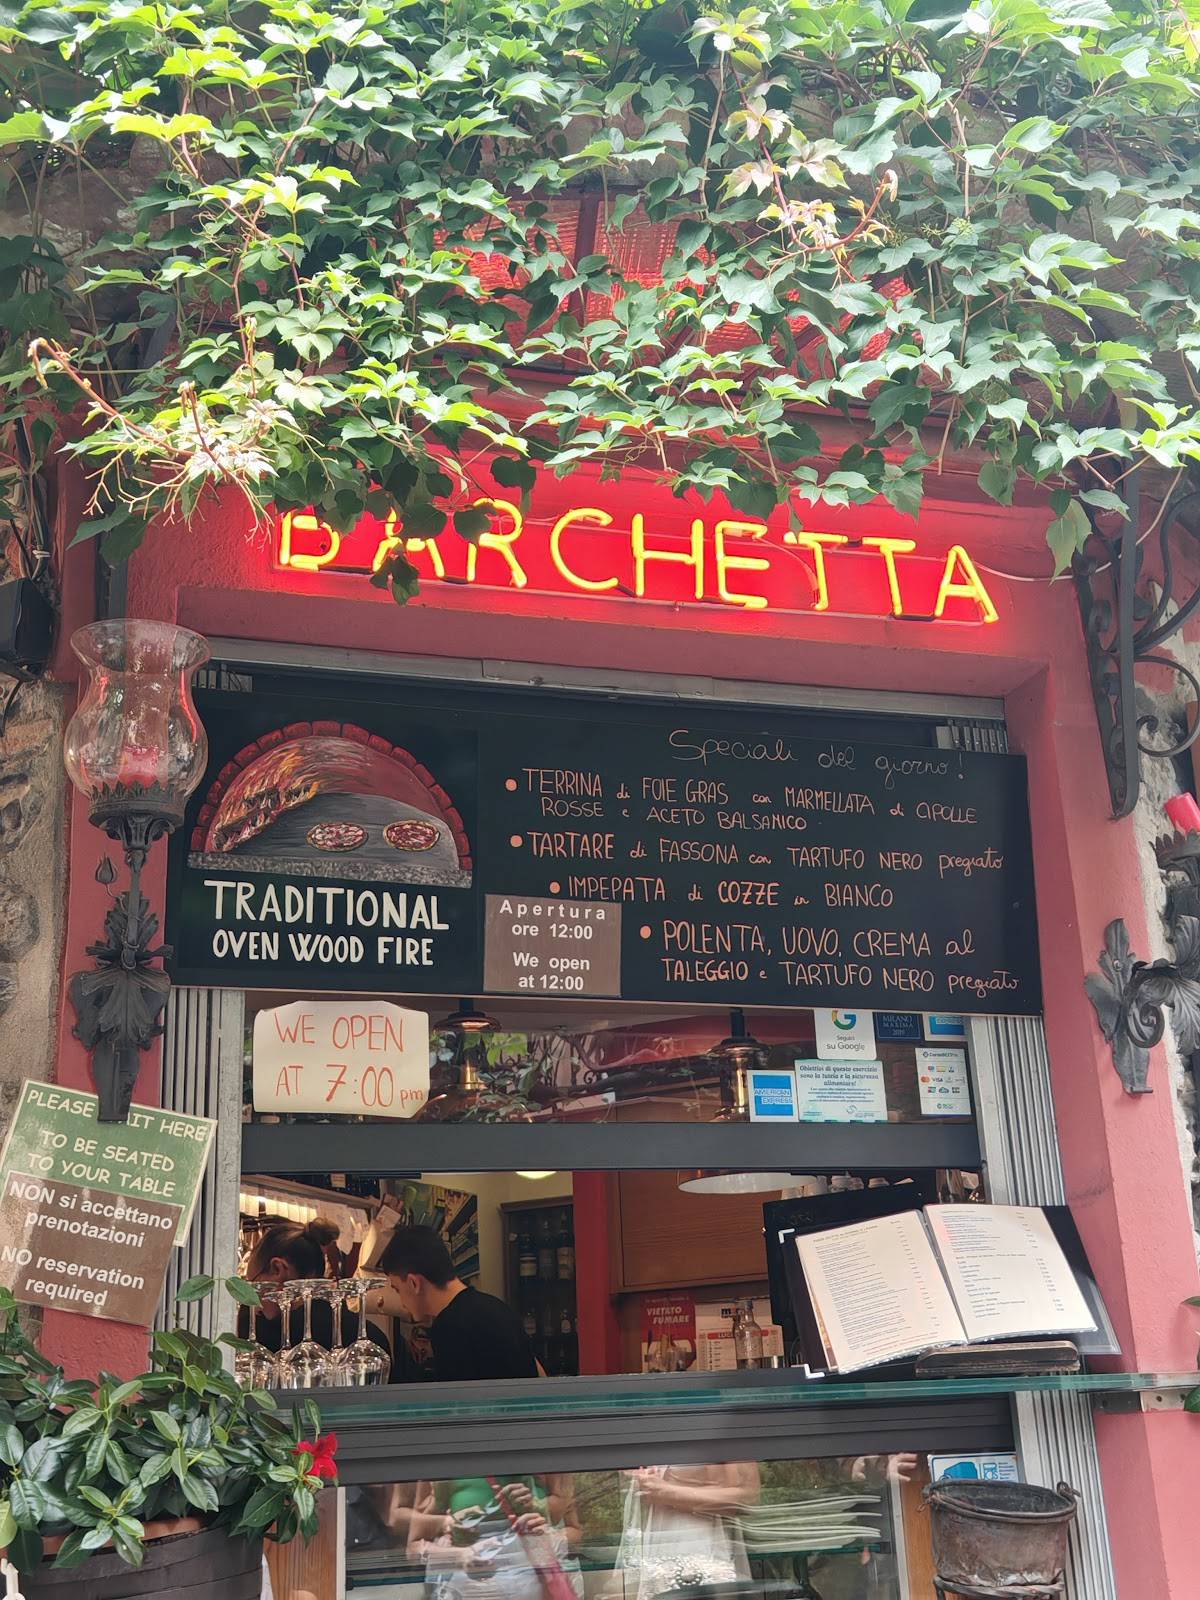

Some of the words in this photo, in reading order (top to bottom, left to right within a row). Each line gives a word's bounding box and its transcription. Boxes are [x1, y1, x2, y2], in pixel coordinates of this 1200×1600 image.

[669, 729, 798, 767] Speciali
[818, 745, 856, 770] del
[522, 768, 602, 798] TERRINA
[616, 783, 631, 800] di
[642, 777, 677, 802] FOIE
[685, 779, 729, 805] GRAS
[752, 793, 772, 804] con
[785, 786, 876, 816] MARMELLATA
[889, 802, 905, 817] di
[541, 797, 604, 818] ROSSE
[646, 807, 705, 827] ACETO
[527, 831, 615, 860] TARTARE
[630, 841, 647, 859] di
[659, 838, 739, 865] FASSONA
[749, 854, 772, 865] con
[786, 846, 865, 870] TARTUFO
[879, 851, 923, 870] NERO
[938, 847, 1004, 879] pregiato
[203, 879, 450, 931] TRADITIONAL
[499, 899, 606, 920] Apertura
[568, 875, 666, 903] IMPEPATA
[688, 883, 704, 902] di
[718, 880, 780, 906] COZZE
[824, 882, 893, 907] BIANCO
[212, 929, 279, 961] OVEN
[288, 933, 364, 963] WOOD
[377, 936, 434, 966] FIRE
[512, 924, 539, 936] ore
[550, 923, 593, 940] 12:00
[663, 919, 772, 956] POLENTA,
[854, 930, 931, 957] CREMA
[945, 928, 975, 955] al
[512, 951, 539, 967] We
[549, 957, 591, 972] open
[661, 958, 749, 984] TALEGGIO
[778, 961, 872, 987] TARTUFO
[883, 967, 935, 992] NERO
[948, 970, 1019, 998] pregiato
[518, 975, 535, 989] at
[539, 974, 584, 991] 12:00
[274, 1012, 315, 1044] WE
[332, 1014, 404, 1053] OPEN
[837, 1041, 866, 1052] Google
[275, 1065, 304, 1096] AT
[326, 1064, 394, 1107] 7:00
[400, 1088, 423, 1110] pm
[754, 1088, 791, 1097] AMERICAN
[27, 1089, 96, 1118] PLEASE
[159, 1118, 209, 1141] HERE
[41, 1130, 68, 1149] TO
[73, 1137, 98, 1156] BE
[102, 1145, 175, 1172] SEATED
[28, 1152, 54, 1171] TO
[62, 1159, 110, 1184] YOUR
[119, 1172, 176, 1197] TABLE
[9, 1181, 55, 1205] NON
[59, 1193, 78, 1210] si
[81, 1199, 173, 1230] accettano
[24, 1211, 146, 1249] prenotazioni
[1, 1245, 32, 1266] NO
[36, 1253, 145, 1290] reservation
[25, 1277, 108, 1307] required
